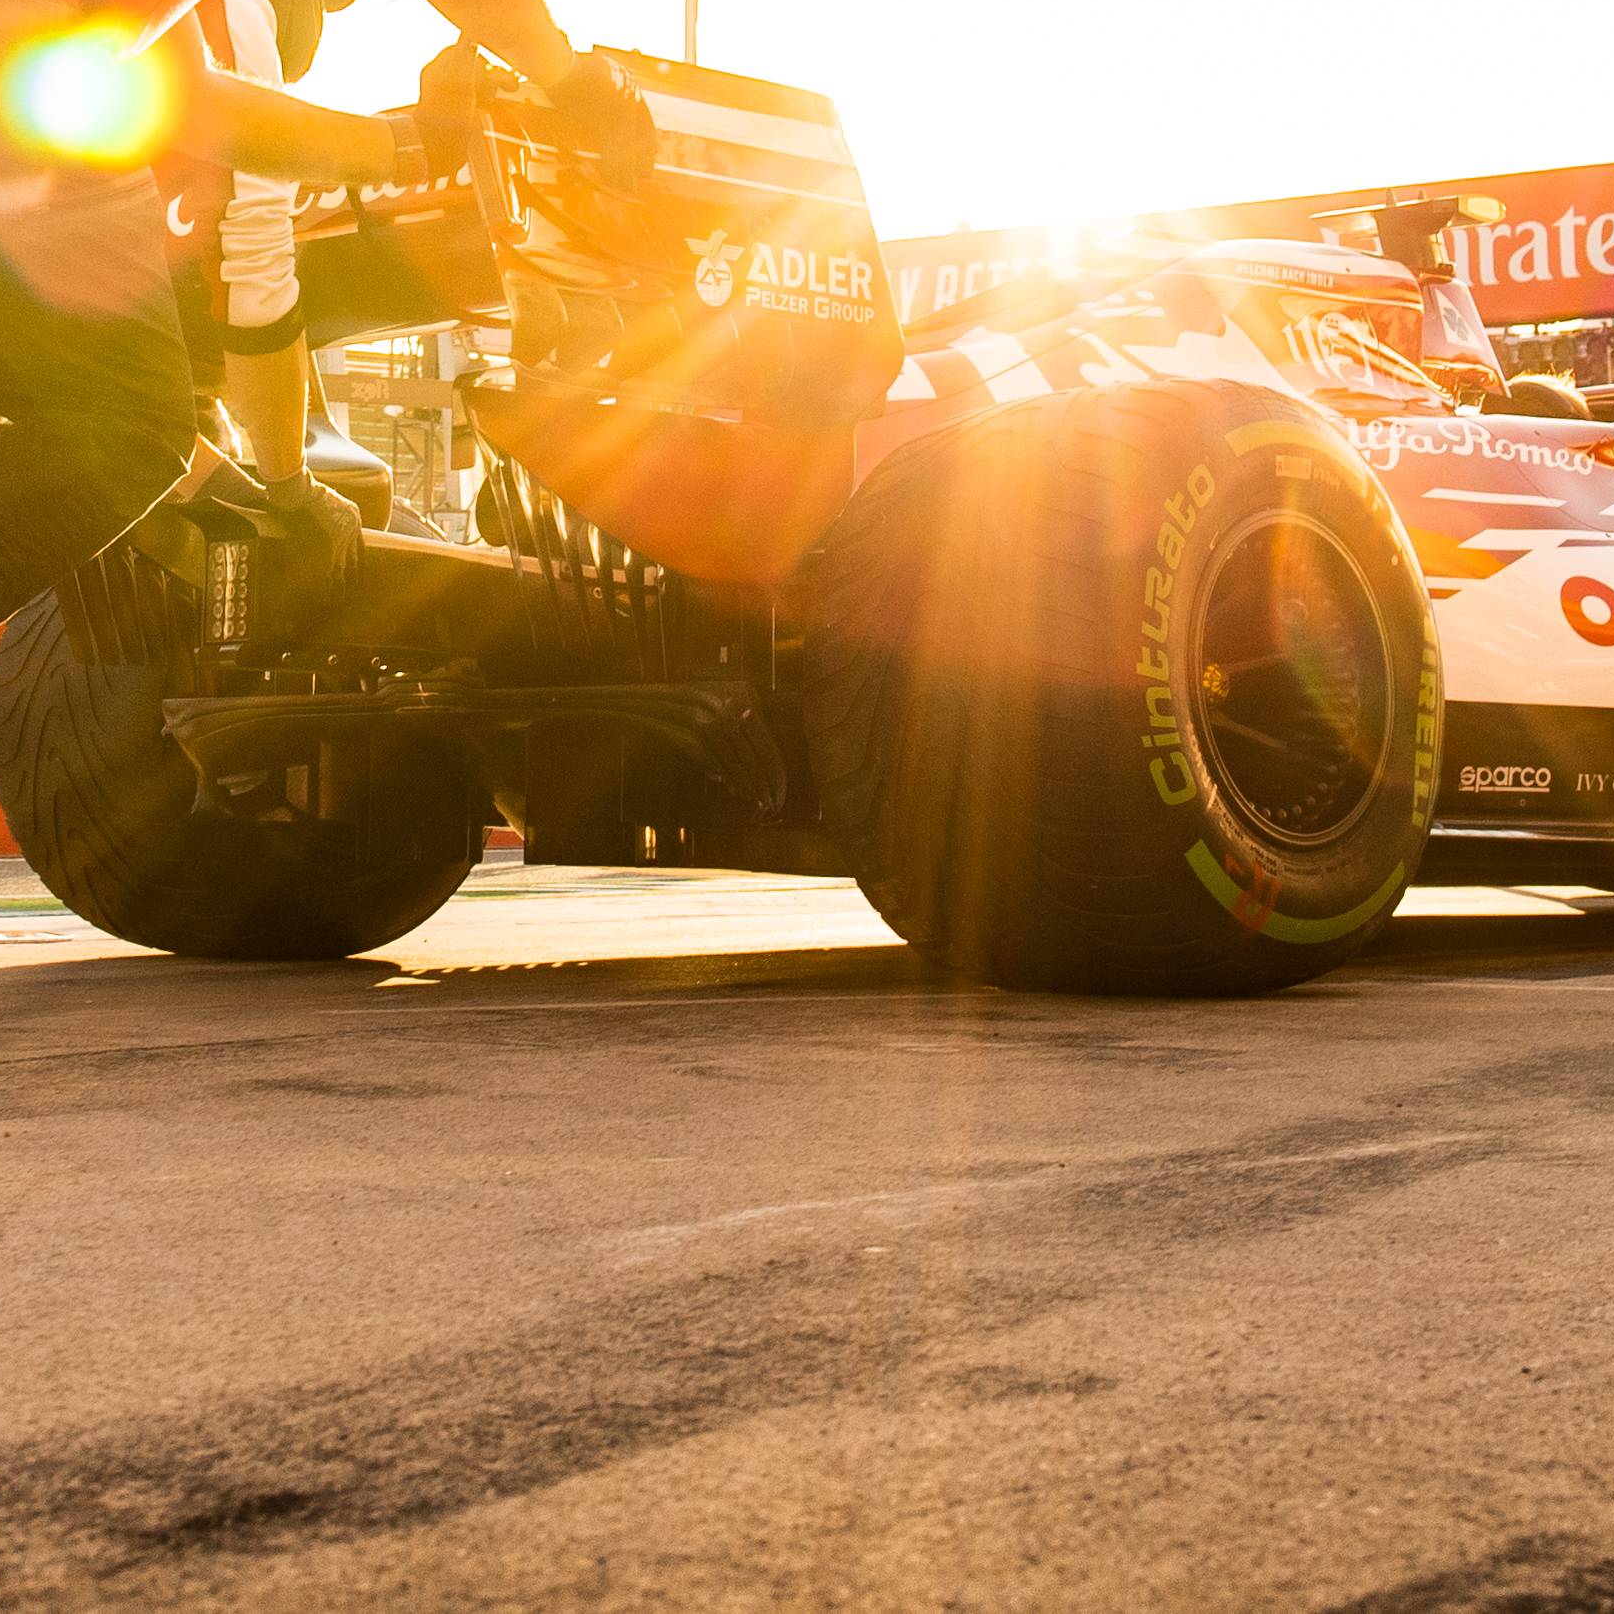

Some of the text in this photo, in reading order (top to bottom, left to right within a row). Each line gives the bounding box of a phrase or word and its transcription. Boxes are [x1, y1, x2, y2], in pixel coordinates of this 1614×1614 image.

[745, 241, 873, 302] ADLER
[1234, 262, 1282, 281] WELCOME
[1282, 266, 1306, 284] BACK
[745, 285, 876, 325] PELZER GROUP
[1436, 418, 1595, 475] Romeo
[1460, 765, 1552, 793] sparco
[1575, 772, 1609, 792] IVY
